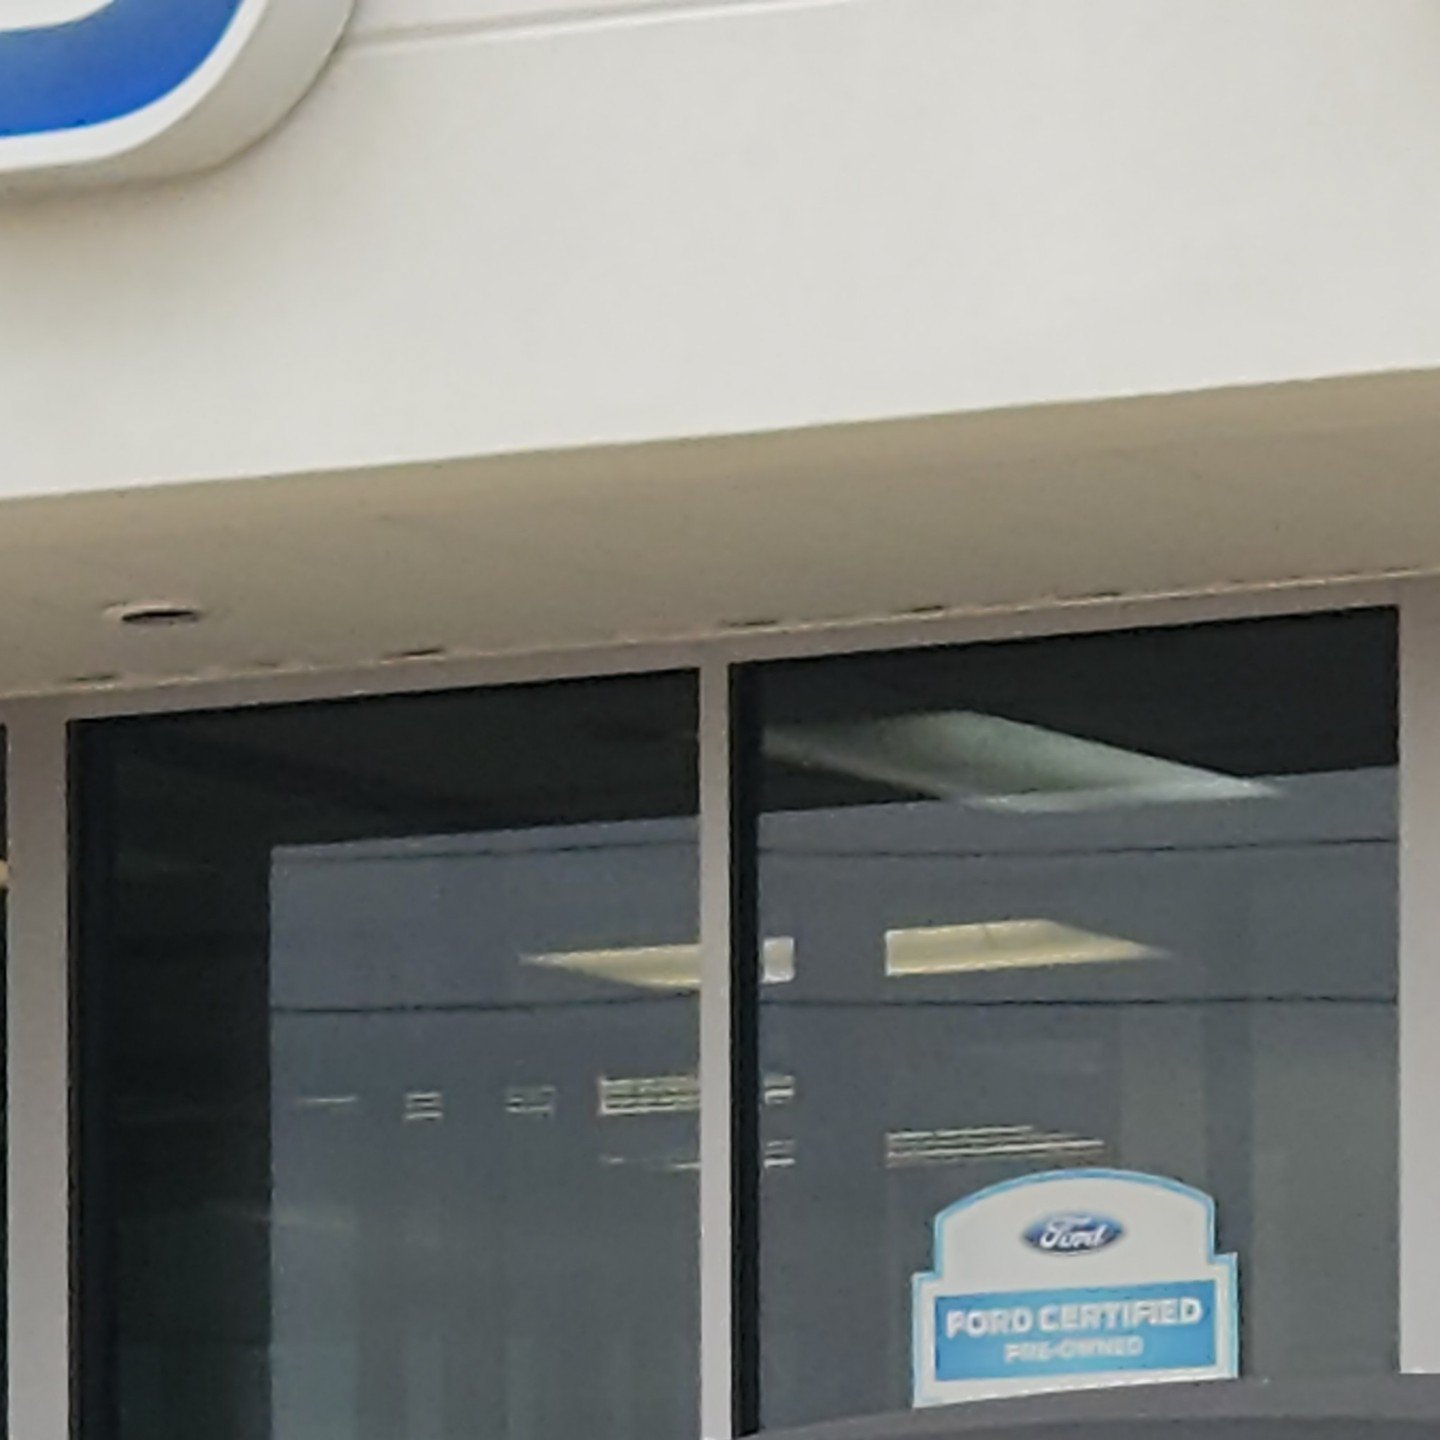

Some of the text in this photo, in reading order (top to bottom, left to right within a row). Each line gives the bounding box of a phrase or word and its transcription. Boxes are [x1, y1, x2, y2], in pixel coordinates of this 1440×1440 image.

[1039, 1215, 1106, 1250] Ford
[946, 1297, 1203, 1339] FORD CERTIFIED
